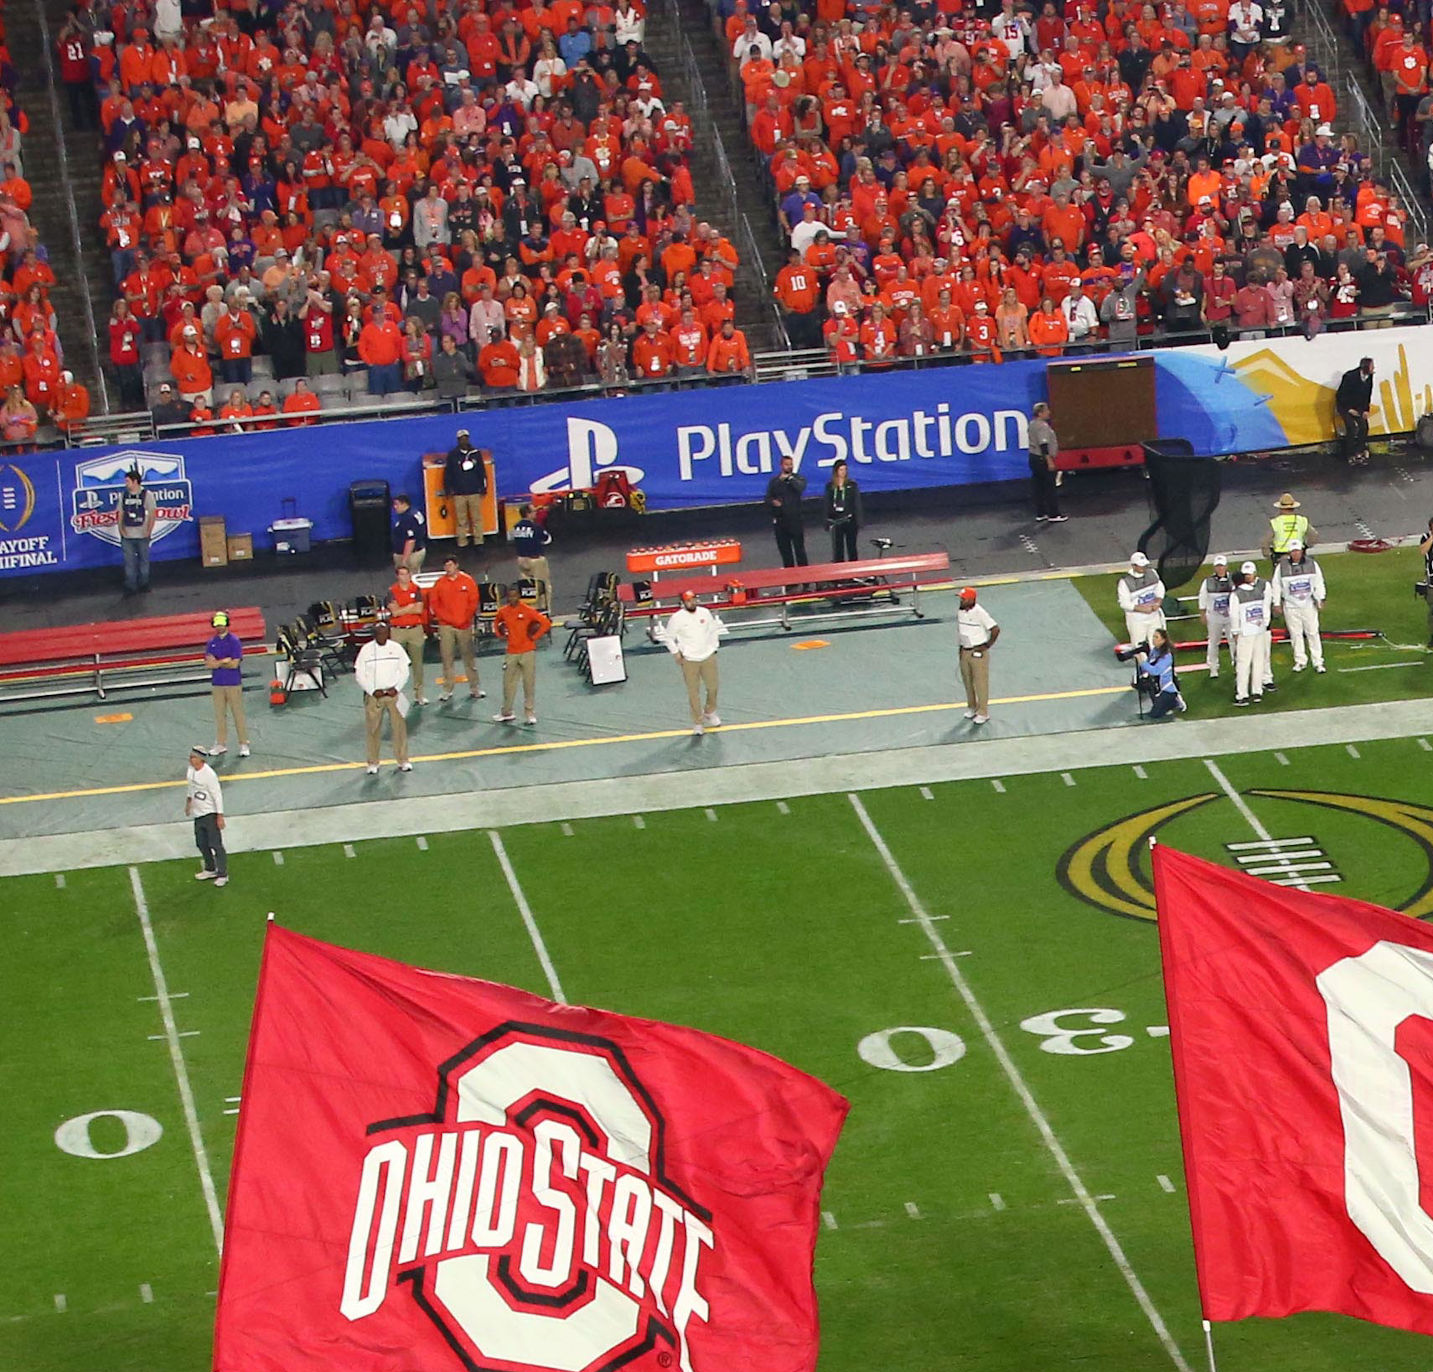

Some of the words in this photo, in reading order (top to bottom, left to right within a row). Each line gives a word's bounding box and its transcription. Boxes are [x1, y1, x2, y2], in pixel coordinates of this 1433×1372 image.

[67, 42, 84, 61] 21
[791, 276, 806, 291] 10
[979, 326, 989, 340] 3
[677, 403, 1030, 481] PlayStation
[655, 551, 718, 566] GATORADE
